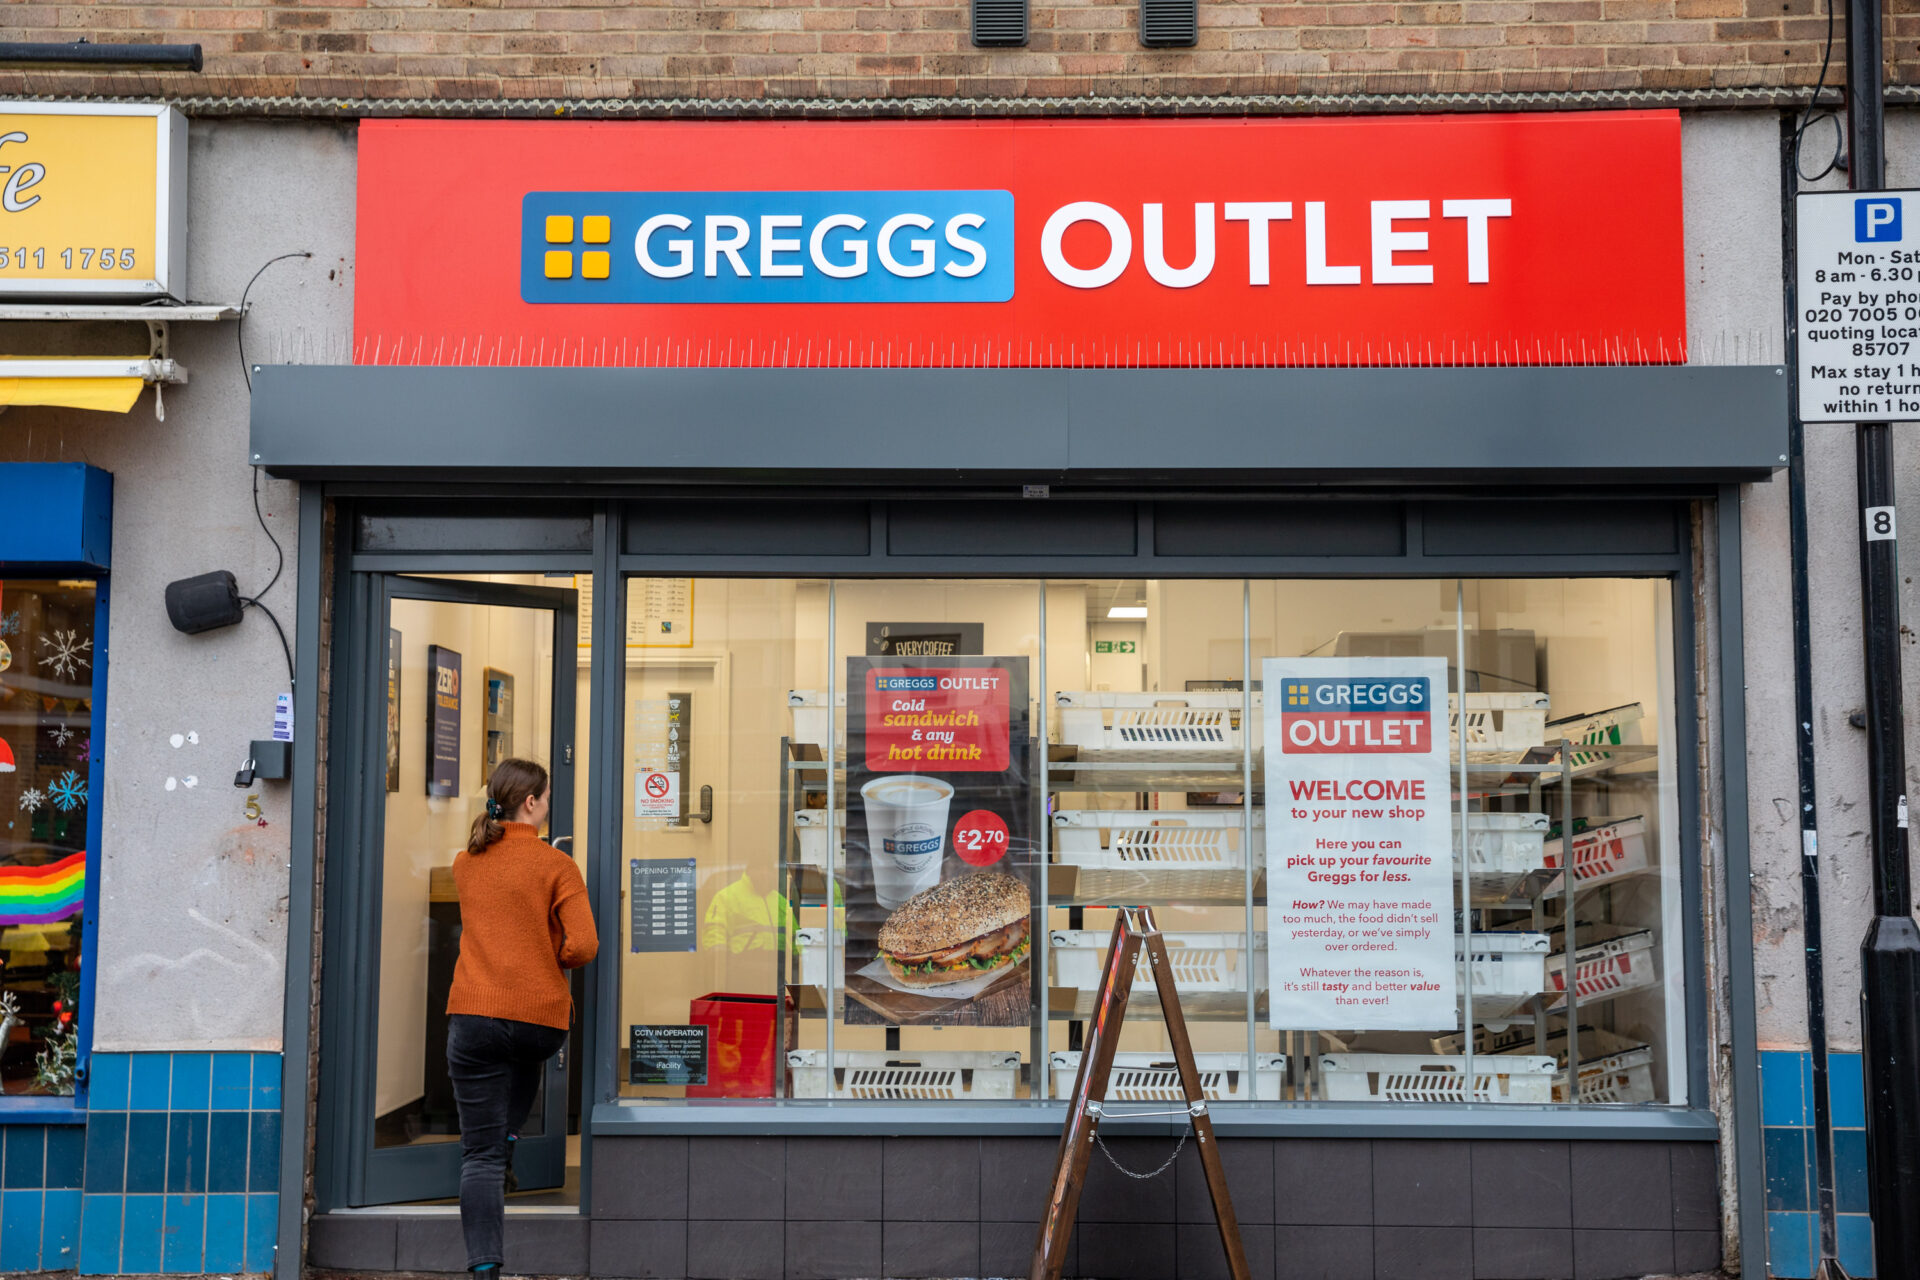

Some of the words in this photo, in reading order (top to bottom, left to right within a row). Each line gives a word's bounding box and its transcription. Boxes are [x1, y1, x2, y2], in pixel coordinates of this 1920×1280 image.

[1867, 203, 1895, 238] P
[634, 213, 987, 278] GREGGS
[1040, 199, 1512, 288] OUTLET
[61, 248, 136, 270] 1755
[1838, 252, 1875, 265] Mon
[1890, 250, 1920, 264] Sat
[1815, 270, 1826, 283] 8
[1830, 272, 1856, 282] am
[1871, 267, 1913, 281] 6.30
[1821, 292, 1852, 308] Pay
[1858, 291, 1879, 307] by
[1885, 290, 1920, 306] pho
[1805, 309, 1842, 323] 020
[1848, 308, 1898, 322] 7005
[1808, 327, 1875, 342] quoting
[1881, 325, 1920, 339] loca
[1852, 342, 1910, 356] 85707
[1811, 366, 1848, 379] Max
[1853, 365, 1891, 380] stay
[1897, 364, 1904, 377] 1
[1839, 385, 1861, 396] no
[1867, 382, 1920, 395] return
[1824, 400, 1878, 413] within
[1885, 399, 1891, 412] 1
[1873, 511, 1892, 535] 8
[895, 641, 922, 656] EVERY
[889, 679, 935, 688] GREGGS
[940, 678, 999, 690] OUTLET
[1315, 684, 1423, 705] GREGGS
[892, 699, 926, 711] Cold
[884, 710, 979, 727] sandwich
[911, 729, 922, 741] &
[926, 731, 955, 744] any
[1289, 719, 1423, 746] OUTLET
[888, 744, 922, 760] hot
[927, 744, 982, 760] drink
[1289, 780, 1426, 800] WELCOME
[245, 793, 261, 820] 5
[1291, 807, 1307, 818] to
[1312, 808, 1347, 822] your
[1352, 808, 1384, 818] new
[1388, 805, 1425, 821] shop
[896, 839, 939, 853] GREGGS
[957, 829, 1005, 850] £2.70
[1316, 838, 1348, 849] Here
[1351, 840, 1375, 852] you
[1379, 840, 1402, 849] can
[1287, 854, 1315, 868] pick
[1319, 857, 1336, 868] up
[1339, 857, 1369, 868] your
[1372, 854, 1432, 865] favourite
[634, 867, 669, 875] OPENING
[670, 866, 692, 874] TIMES
[1307, 871, 1356, 885] Greggs
[1360, 870, 1379, 881] for
[1382, 871, 1411, 882] less.
[1292, 900, 1325, 909] How?
[1327, 900, 1345, 909] We
[1348, 902, 1370, 911] may
[1373, 900, 1398, 909] have
[1401, 900, 1432, 909] made
[1283, 915, 1300, 923] too
[1304, 914, 1336, 925] much,
[1338, 914, 1355, 923] the
[1358, 914, 1384, 923] food
[1386, 914, 1418, 923] didn't
[1420, 914, 1438, 923] sell
[1291, 928, 1346, 939] yesterday,
[1362, 928, 1393, 937] we've
[1395, 928, 1431, 939] simply
[1325, 943, 1349, 951] over
[1351, 941, 1398, 951] ordered.
[1299, 968, 1351, 977] Whatever
[1354, 968, 1371, 977] the
[1412, 968, 1424, 978] is,
[1284, 982, 1299, 991] it's
[1301, 982, 1319, 991] still
[1322, 982, 1349, 993] tasty
[1351, 982, 1372, 991] and
[1375, 982, 1408, 991] better
[1410, 982, 1440, 991] value
[1335, 996, 1359, 1005] than
[1362, 996, 1389, 1005] ever!
[634, 1029, 654, 1037] CCTV
[654, 1029, 662, 1037] IN
[663, 1029, 704, 1037] OPERATION
